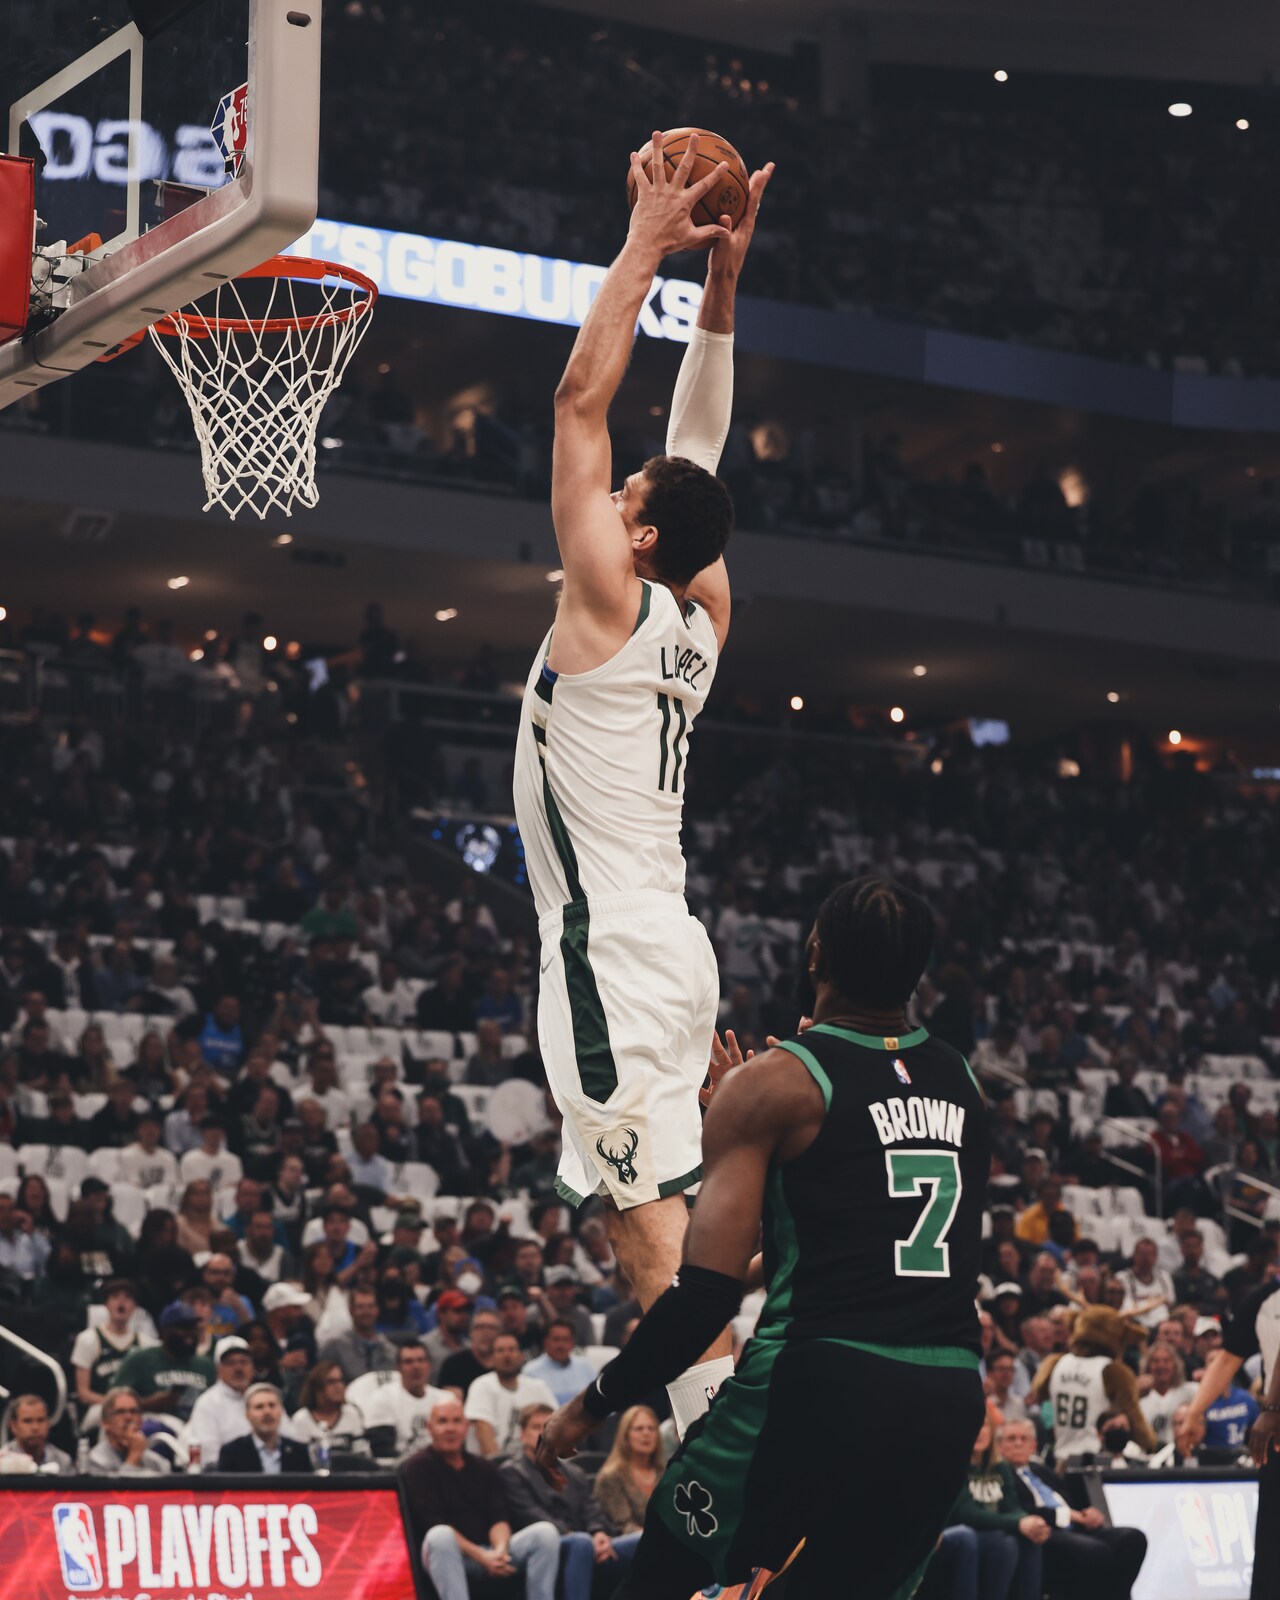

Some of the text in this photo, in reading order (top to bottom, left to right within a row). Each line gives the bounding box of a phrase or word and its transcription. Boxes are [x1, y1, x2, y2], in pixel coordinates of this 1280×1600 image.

[660, 644, 708, 691] LOPEZ
[657, 691, 687, 794] 11
[867, 1096, 966, 1148] BROWN
[884, 1149, 963, 1278] 7
[1056, 1393, 1088, 1429] 68
[103, 1503, 322, 1589] PLAYOFFS
